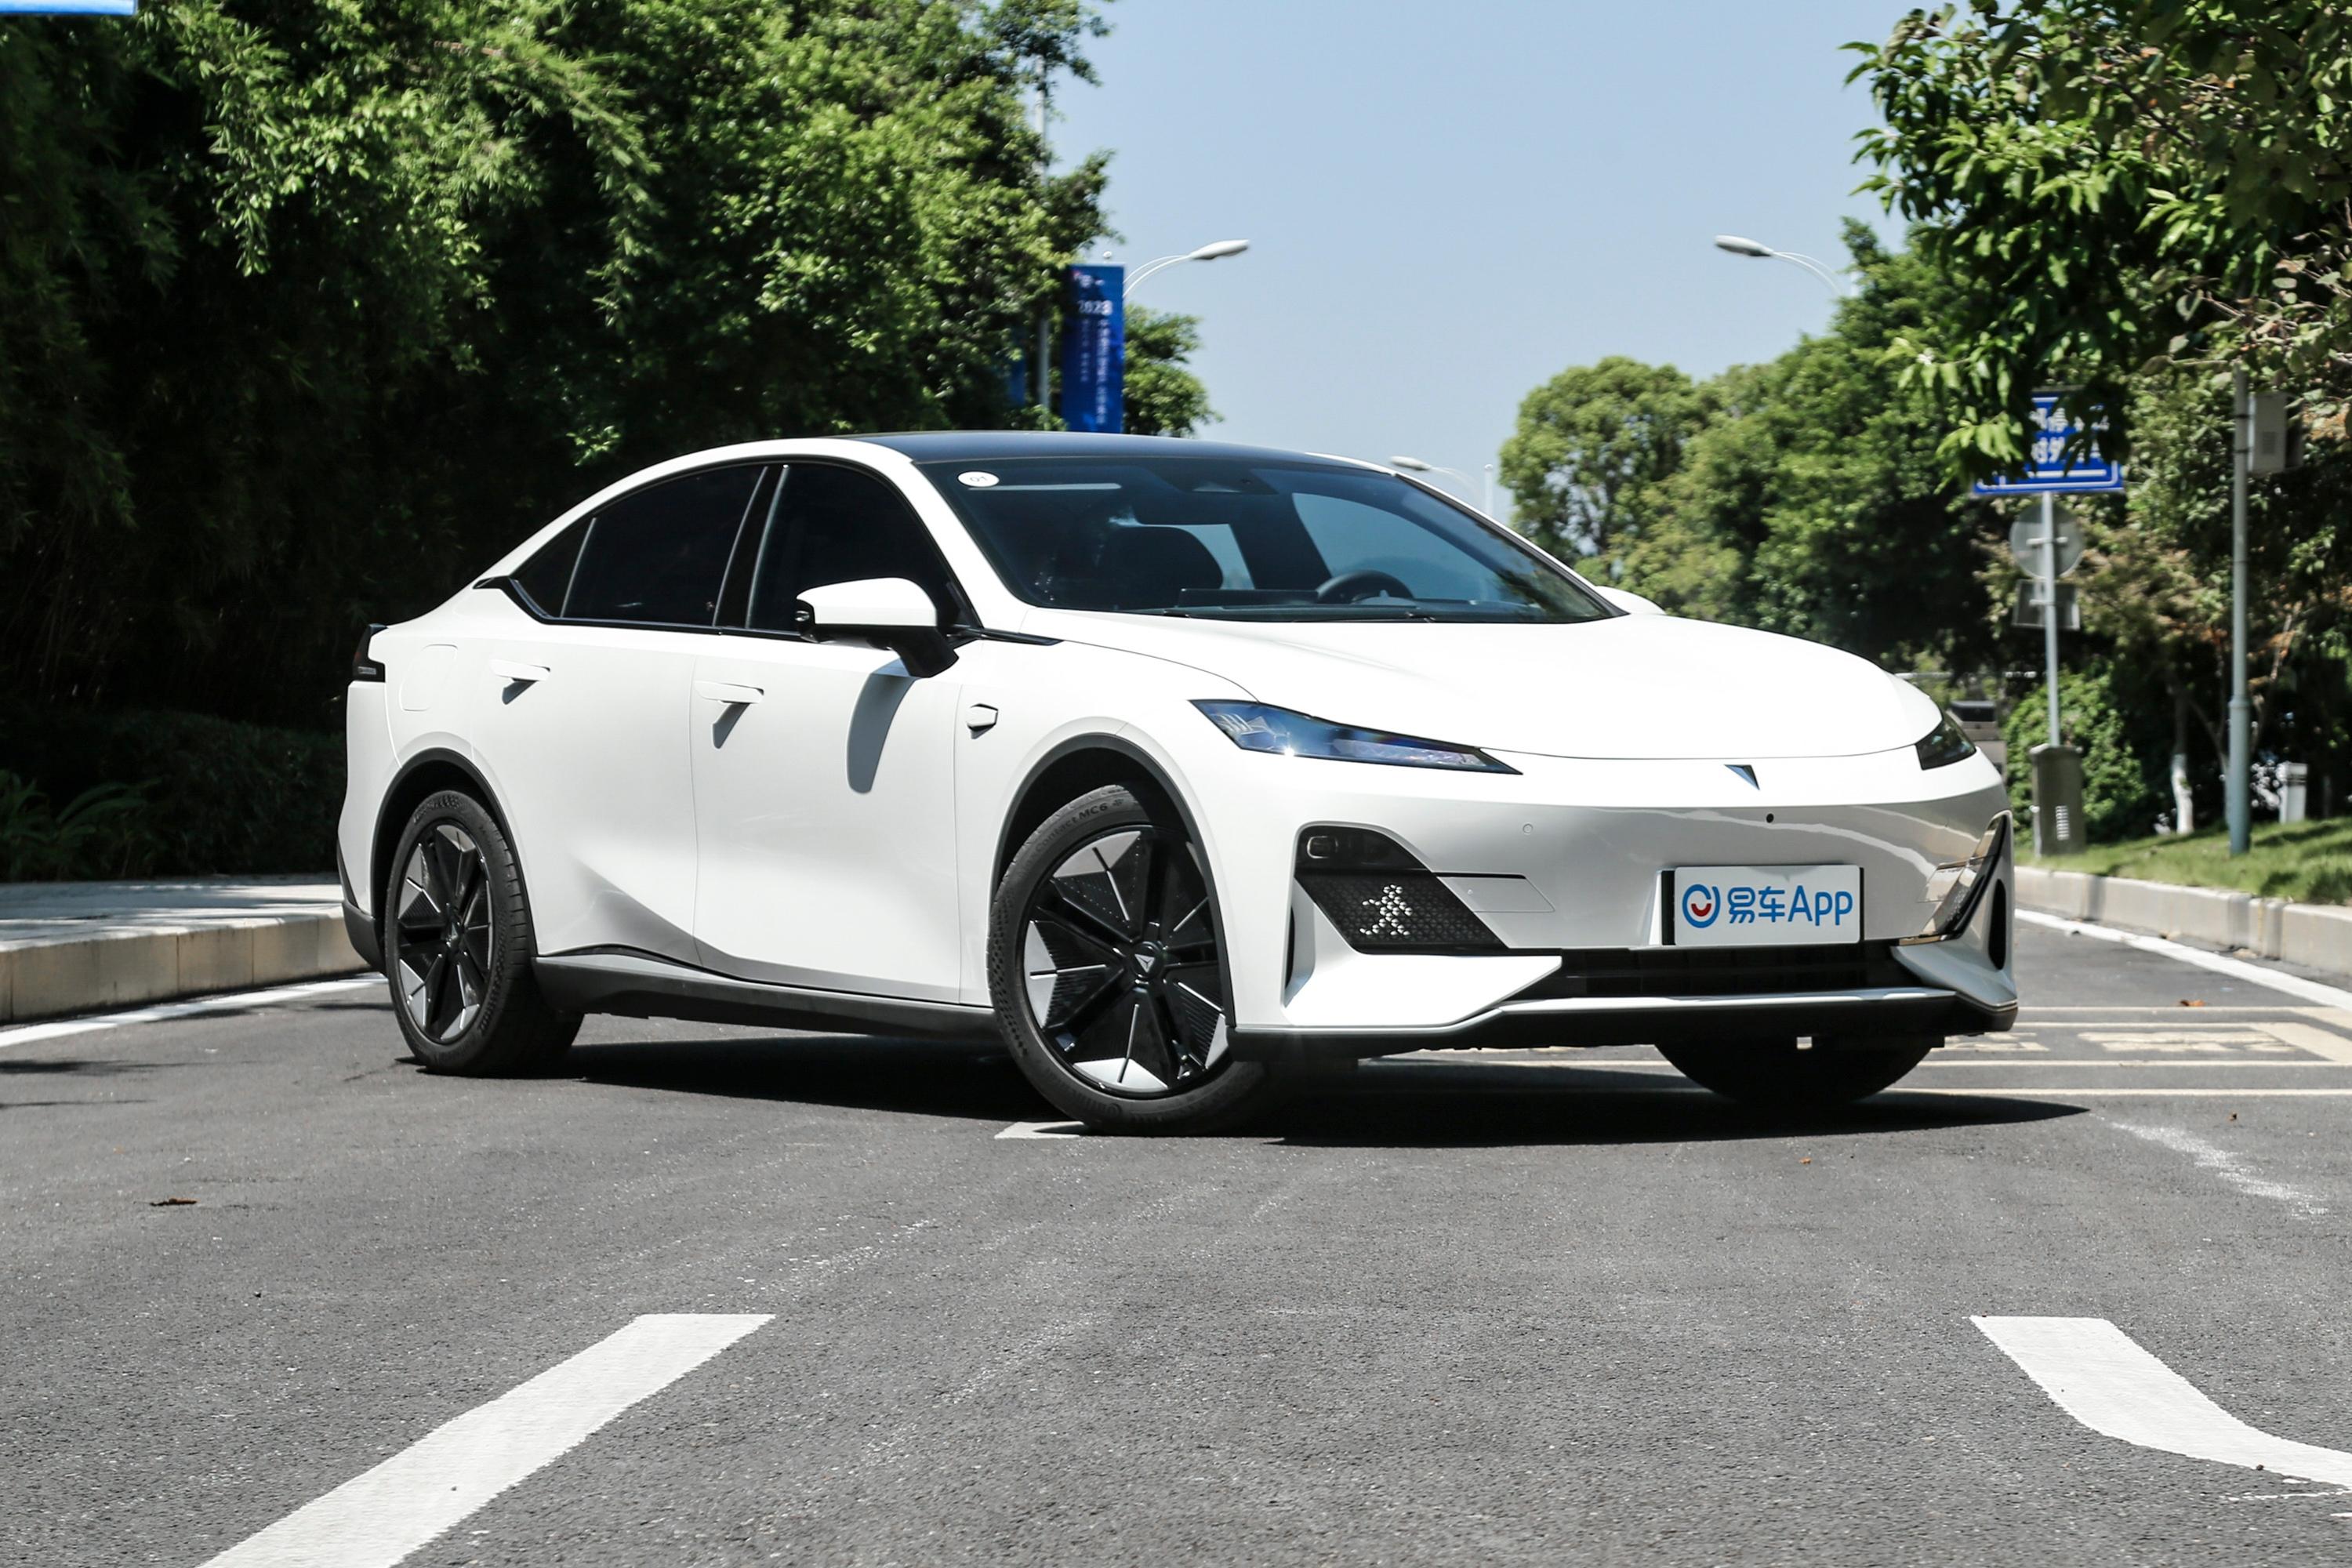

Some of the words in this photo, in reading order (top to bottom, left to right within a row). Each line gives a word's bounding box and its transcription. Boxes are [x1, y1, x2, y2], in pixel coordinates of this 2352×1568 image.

[1077, 299, 1113, 315] 2023
[1079, 802, 1109, 821] MC6
[1727, 885, 1853, 926] 易车App
